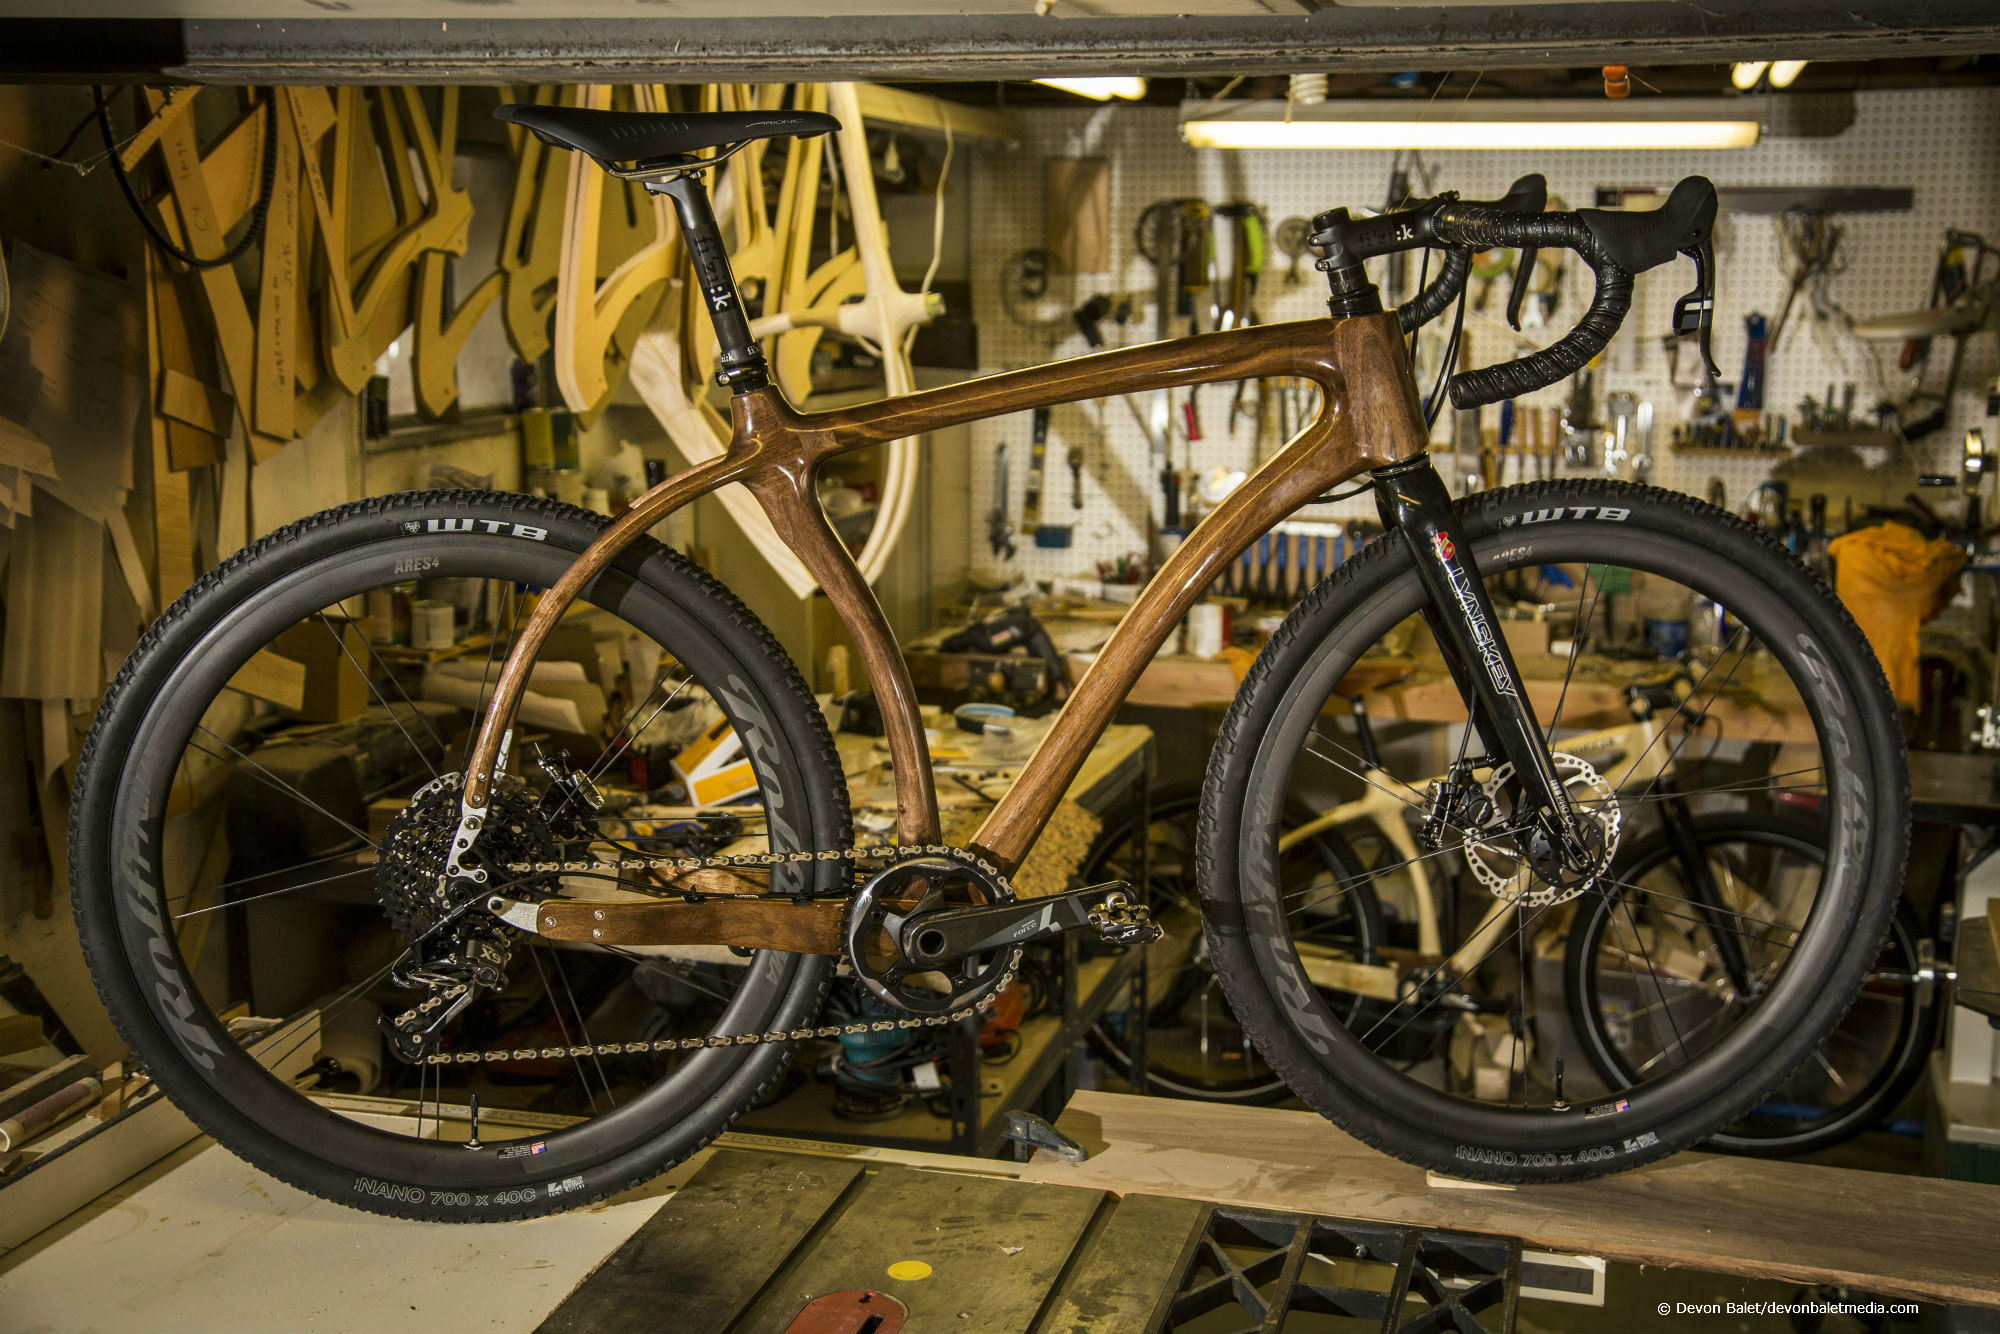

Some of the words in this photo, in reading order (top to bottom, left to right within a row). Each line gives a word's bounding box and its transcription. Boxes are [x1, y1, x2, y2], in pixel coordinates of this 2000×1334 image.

[1521, 506, 1632, 525] WTB
[426, 518, 549, 541] WTB
[1447, 566, 1518, 697] LYNSKEY
[1120, 928, 1141, 939] XT
[1458, 1145, 1518, 1167] NANO
[1520, 1153, 1558, 1168] 700
[1576, 1144, 1616, 1164] 40C
[358, 1176, 425, 1204] NANO
[430, 1190, 471, 1206] 700
[493, 1187, 537, 1205] 40C
